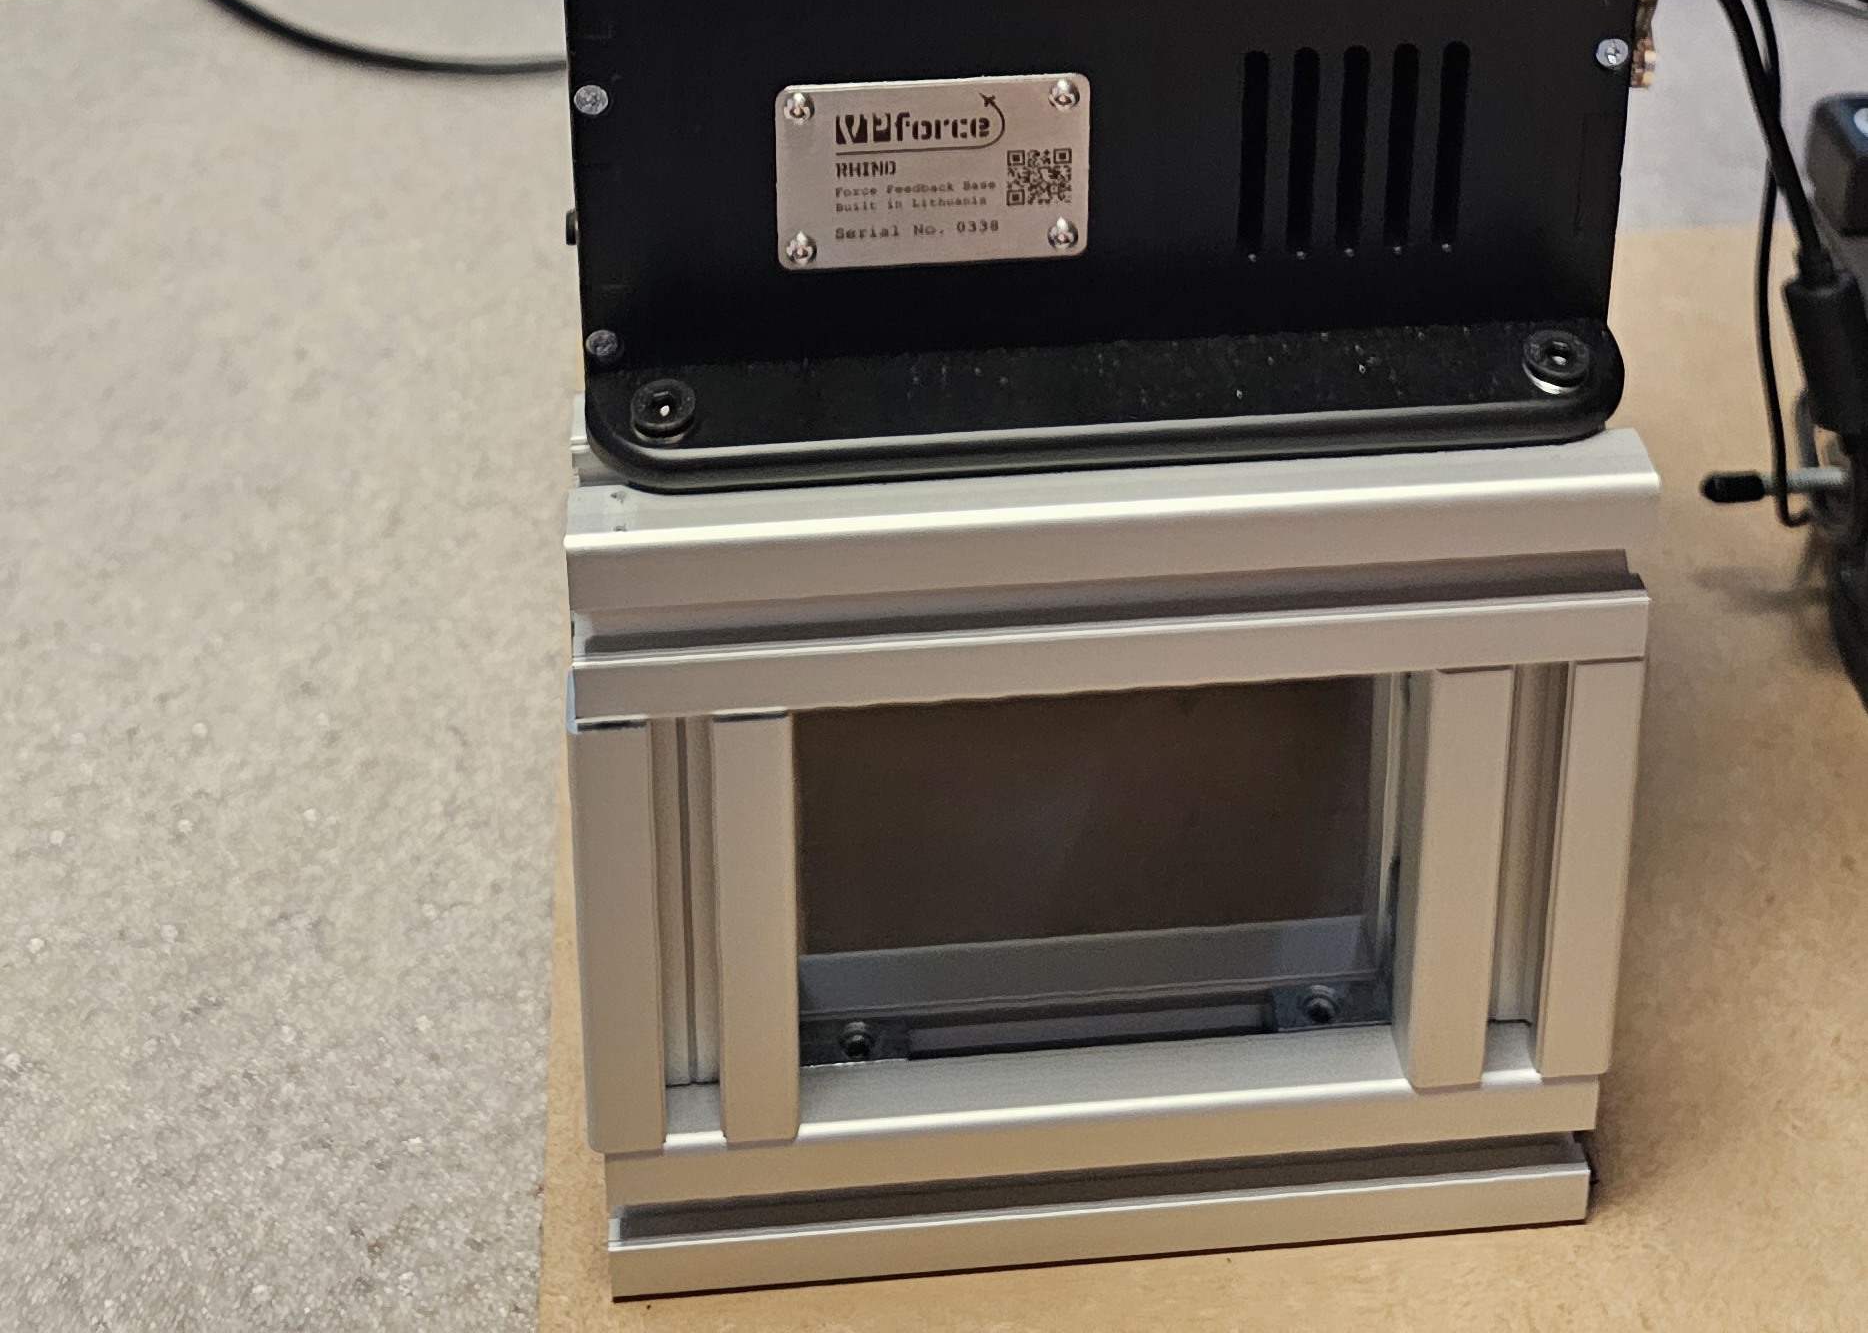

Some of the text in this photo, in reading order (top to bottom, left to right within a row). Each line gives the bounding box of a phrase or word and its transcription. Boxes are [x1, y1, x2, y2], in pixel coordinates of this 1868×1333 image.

[835, 159, 897, 179] RHINO
[835, 180, 997, 199] Force Feedback Base
[835, 195, 987, 213] Built in Lithuania
[834, 224, 900, 240] Serial
[913, 223, 945, 237] No.
